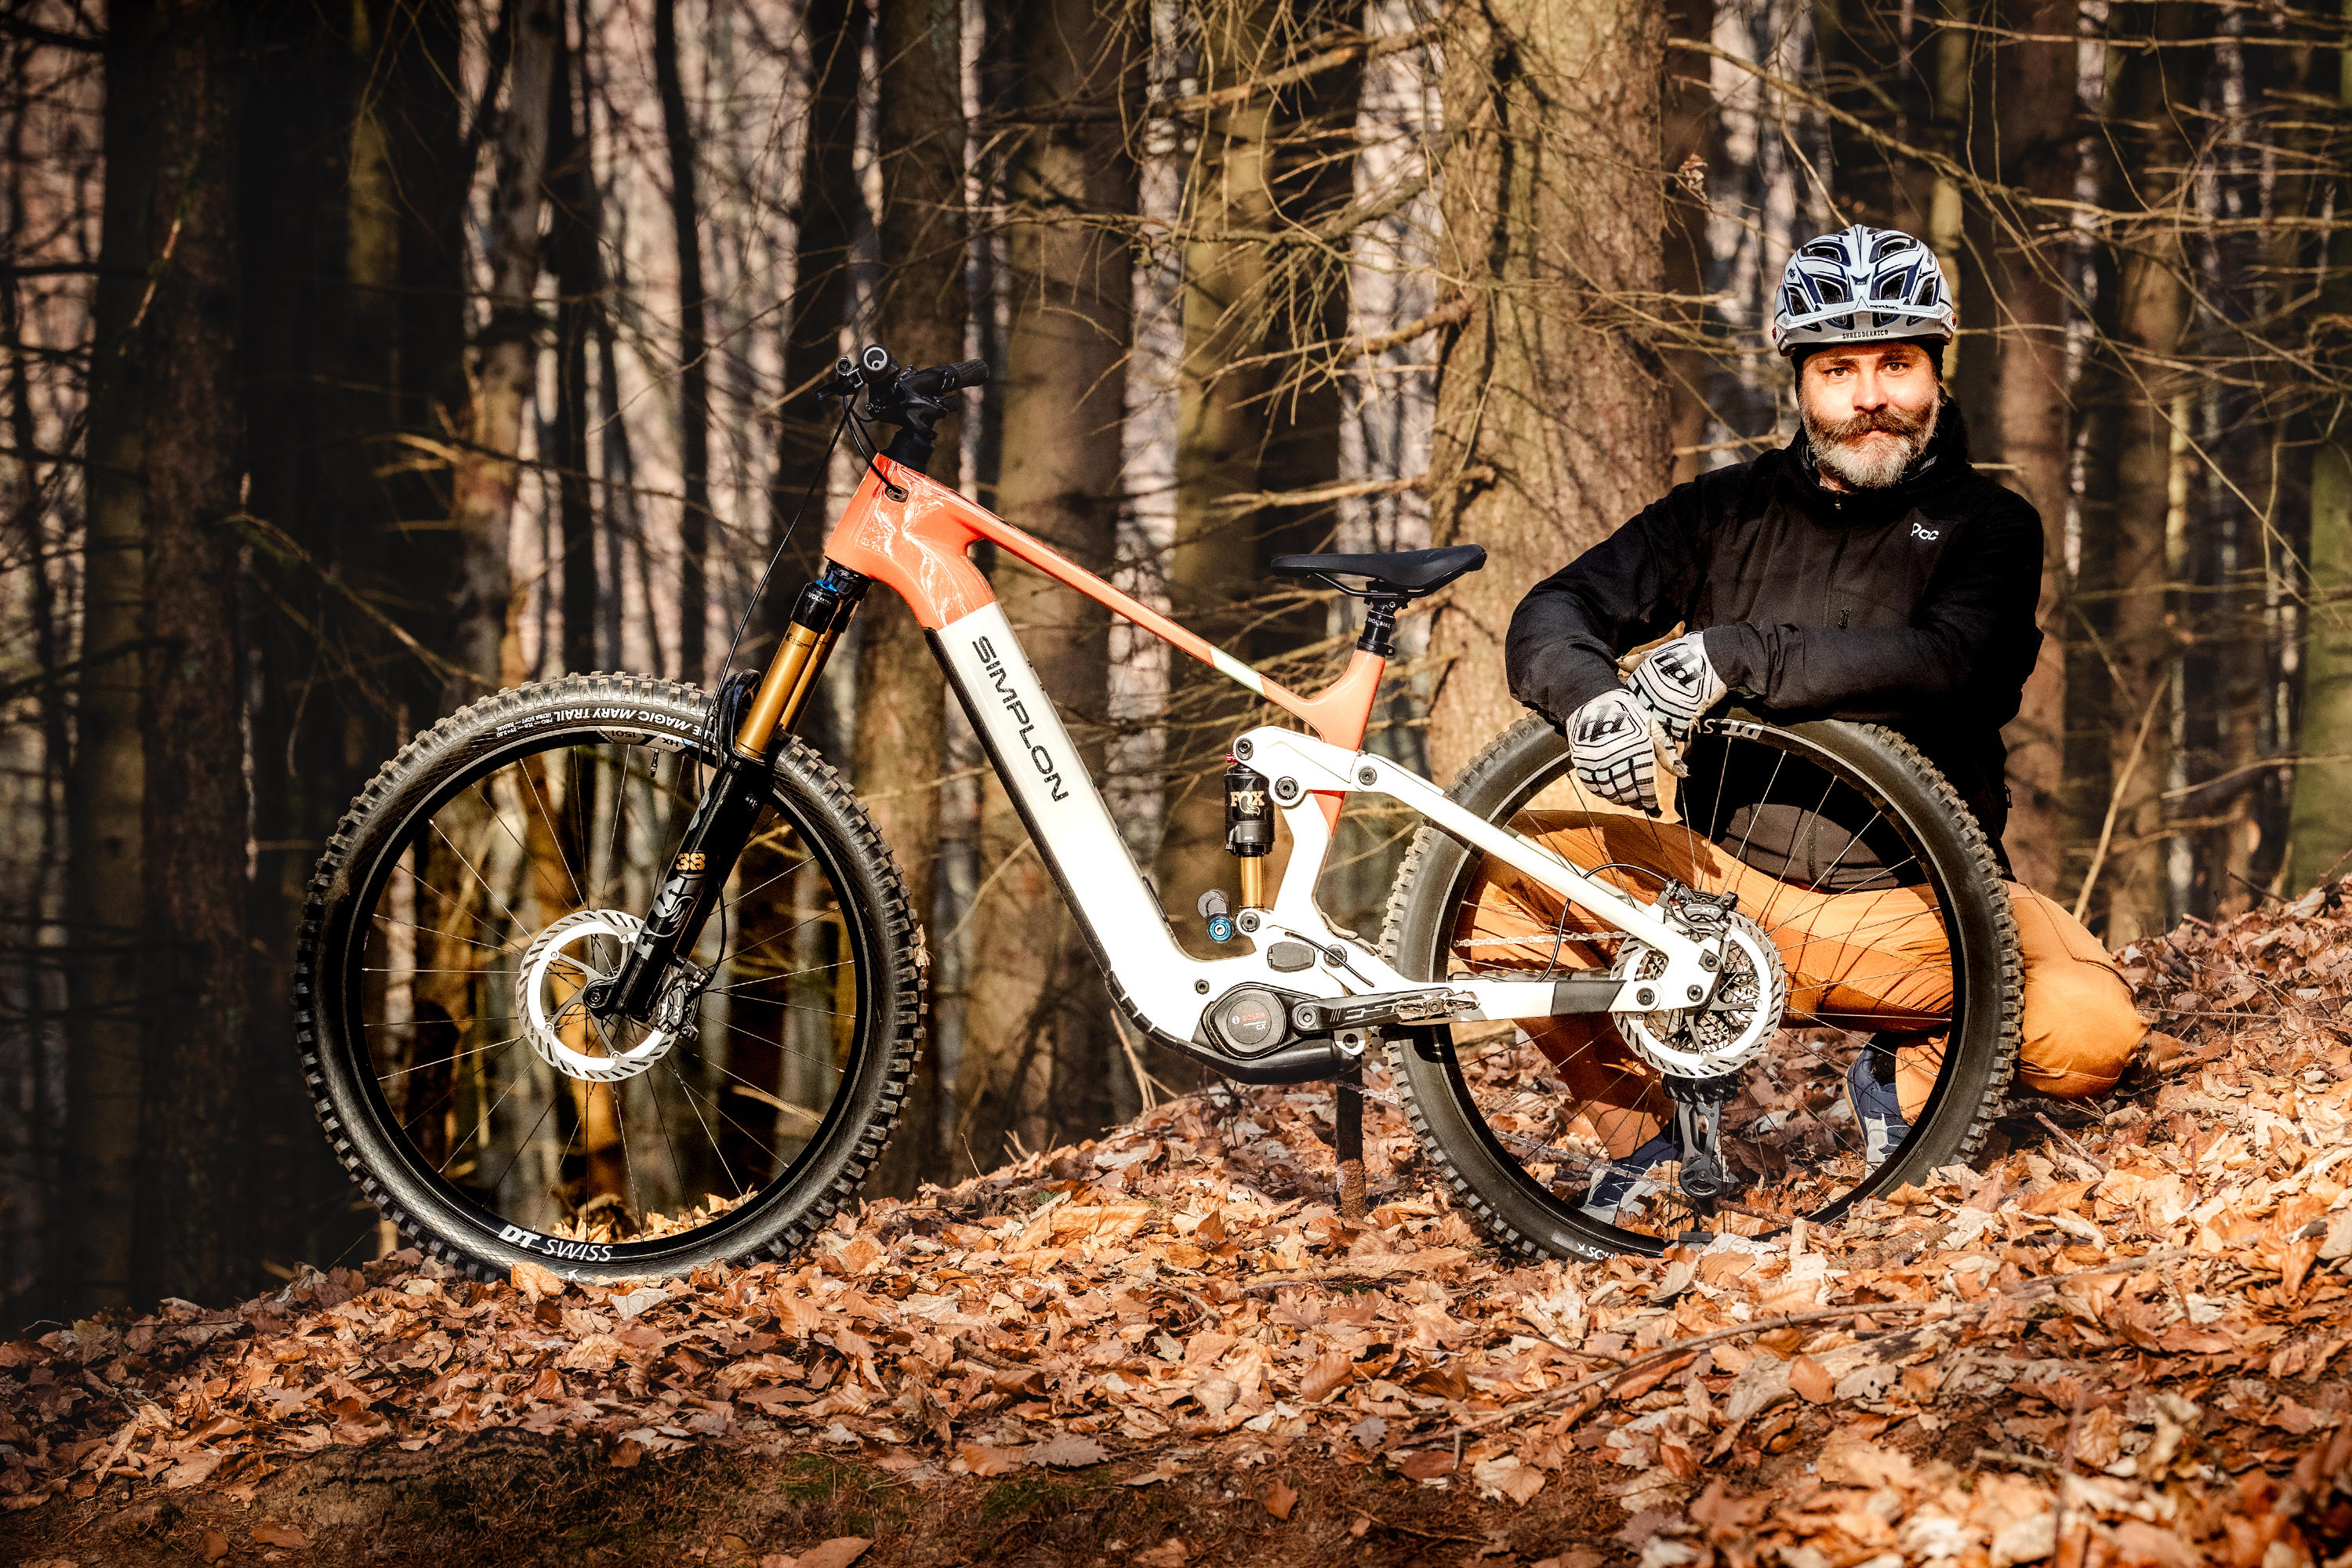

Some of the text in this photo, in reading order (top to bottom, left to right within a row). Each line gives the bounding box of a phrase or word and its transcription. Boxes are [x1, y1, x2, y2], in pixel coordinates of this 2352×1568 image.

[554, 707, 693, 731] MAGIC MARY TRAIL
[972, 636, 1069, 802] SIMPLON
[611, 730, 637, 739] 1501
[1721, 720, 1764, 740] DT
[662, 737, 680, 747] HX
[1230, 790, 1265, 813] FOX
[675, 852, 706, 870] 38
[1700, 906, 1719, 915] XT
[1242, 1012, 1266, 1022] BOSCH
[498, 1224, 614, 1262] DT SWISS
